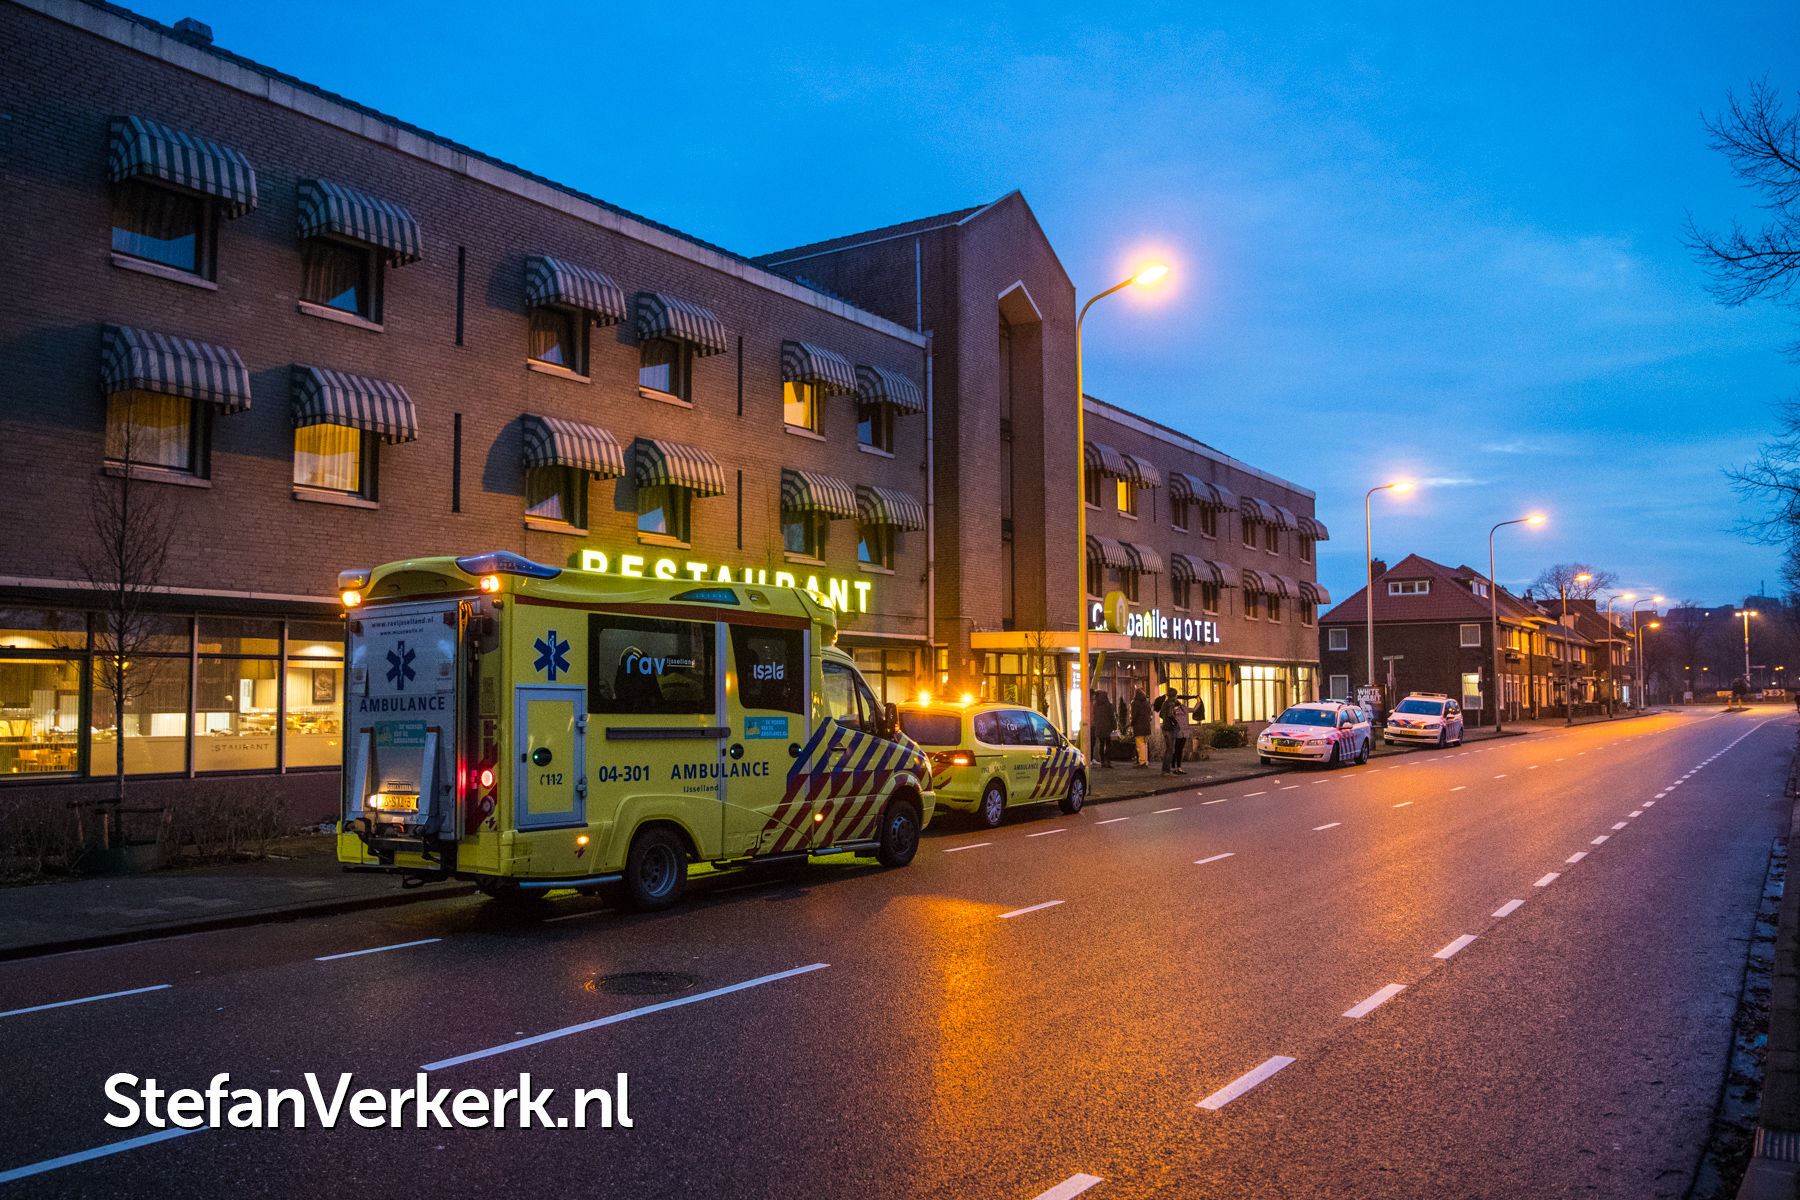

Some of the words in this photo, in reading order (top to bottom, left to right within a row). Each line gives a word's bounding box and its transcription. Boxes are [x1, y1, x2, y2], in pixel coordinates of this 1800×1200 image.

[1092, 602, 1169, 639] Cpanile
[1173, 617, 1220, 643] HOTEL
[626, 654, 665, 675] rav
[1357, 688, 1380, 696] WHITE
[359, 696, 445, 713] AMBULANCE
[599, 765, 649, 782] 04-301
[671, 762, 769, 780] AMBULANCE
[683, 784, 719, 793] IJsselland
